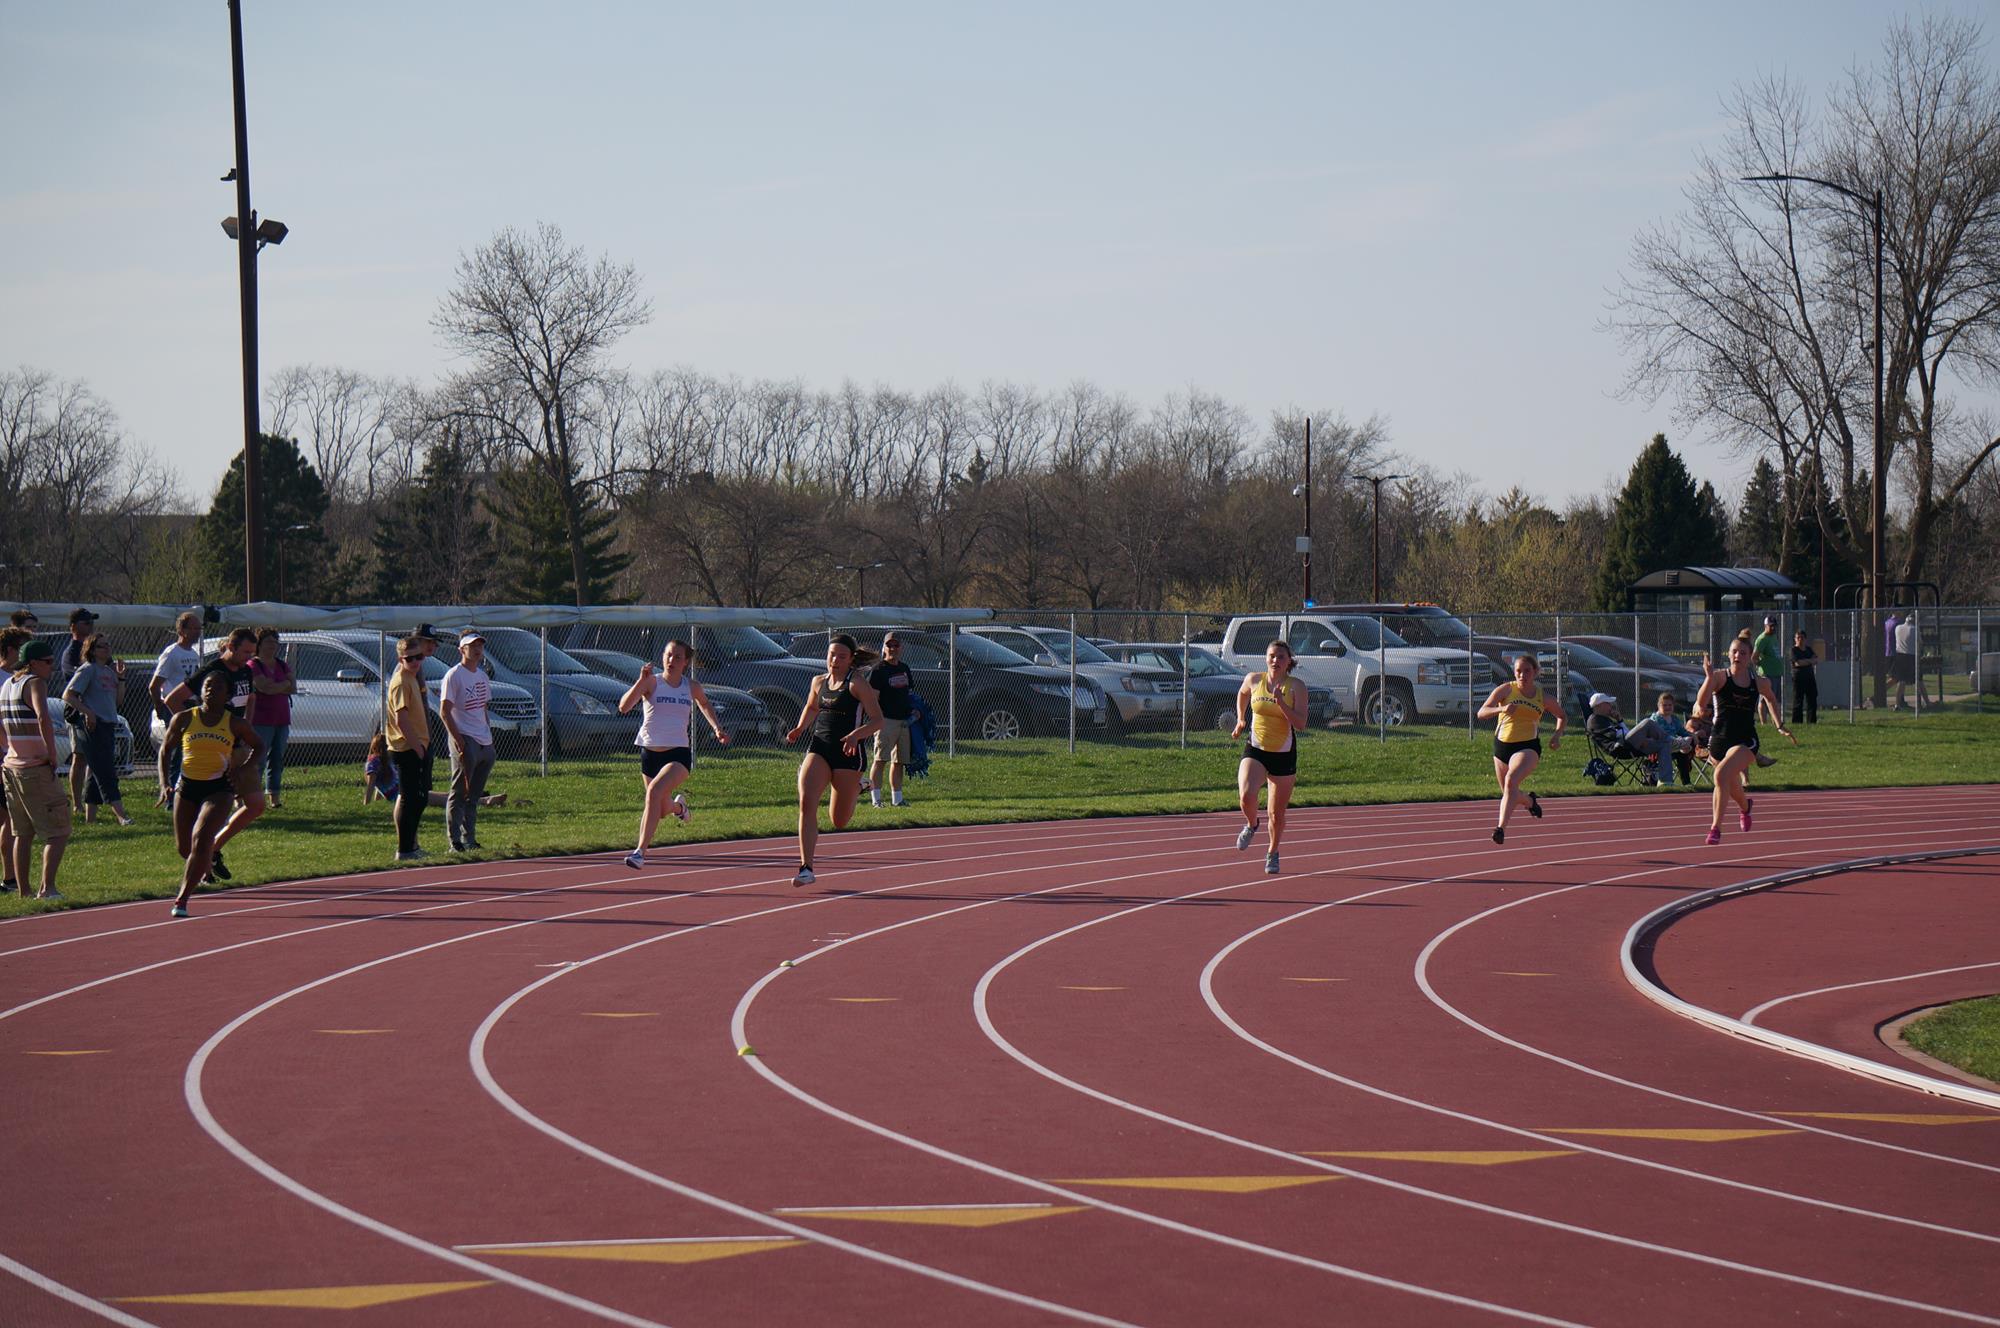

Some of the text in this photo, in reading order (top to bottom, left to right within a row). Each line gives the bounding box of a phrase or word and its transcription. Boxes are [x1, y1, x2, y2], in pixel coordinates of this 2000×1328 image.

[656, 696, 692, 707] UPPER IOW
[186, 732, 230, 746] GUSTAVUS
